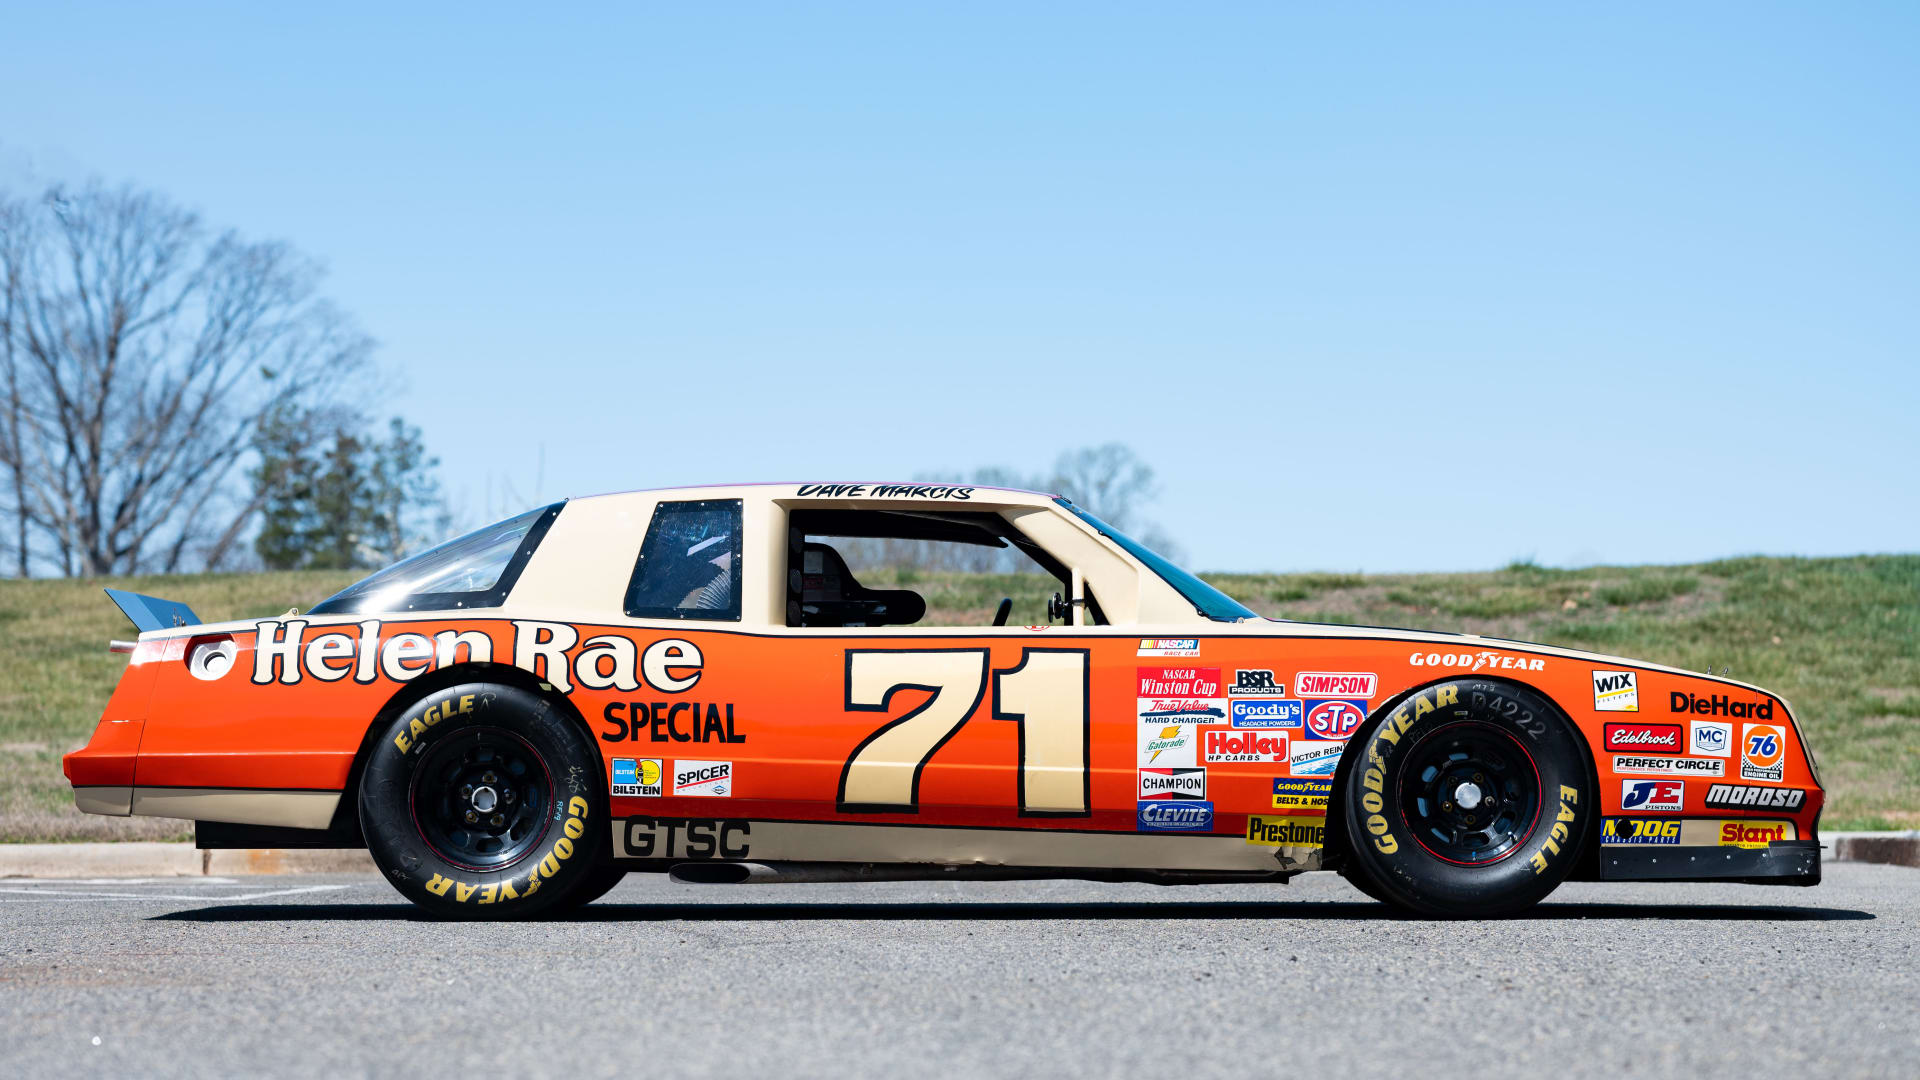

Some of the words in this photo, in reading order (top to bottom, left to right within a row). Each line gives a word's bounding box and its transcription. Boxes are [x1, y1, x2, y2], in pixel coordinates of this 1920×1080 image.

[797, 484, 866, 498] DAVE
[870, 485, 975, 500] MARCIS
[250, 619, 495, 684] Helen
[511, 619, 705, 694] Rae
[1162, 669, 1196, 680] NASCAR
[1236, 670, 1276, 687] BSR
[1595, 673, 1633, 693] WIX
[1140, 678, 1190, 695] Winston
[1192, 678, 1217, 696] Cup
[1301, 676, 1371, 694] SIMPSON
[1233, 703, 1300, 721] Goody's
[1670, 691, 1773, 720] DieHard
[393, 694, 475, 755] EAGLE
[602, 701, 746, 744] SPECIAL
[1314, 705, 1358, 734] STP
[836, 647, 1092, 818] 71
[1611, 729, 1676, 746] Edelbrock
[1699, 729, 1723, 743] MC
[1148, 739, 1185, 751] Gatorade
[1208, 732, 1287, 762] Holley
[1749, 735, 1777, 756] 76
[1291, 750, 1321, 763] VICTOR
[1616, 757, 1673, 769] PERFECT
[1675, 759, 1721, 770] CIRCLE
[677, 764, 730, 786] SPICER
[1142, 778, 1202, 790] CHAMPION
[612, 786, 661, 796] BILSTEIN
[1276, 796, 1299, 805] BELTS
[1301, 797, 1308, 805] &
[1623, 782, 1682, 808] JE
[1706, 784, 1806, 809] MOROSO
[1143, 804, 1208, 822] CLEVITE
[624, 816, 751, 858] GTSC
[1249, 817, 1326, 844] Prestone
[1529, 784, 1578, 875] EAGLE
[1722, 823, 1785, 844] Stant
